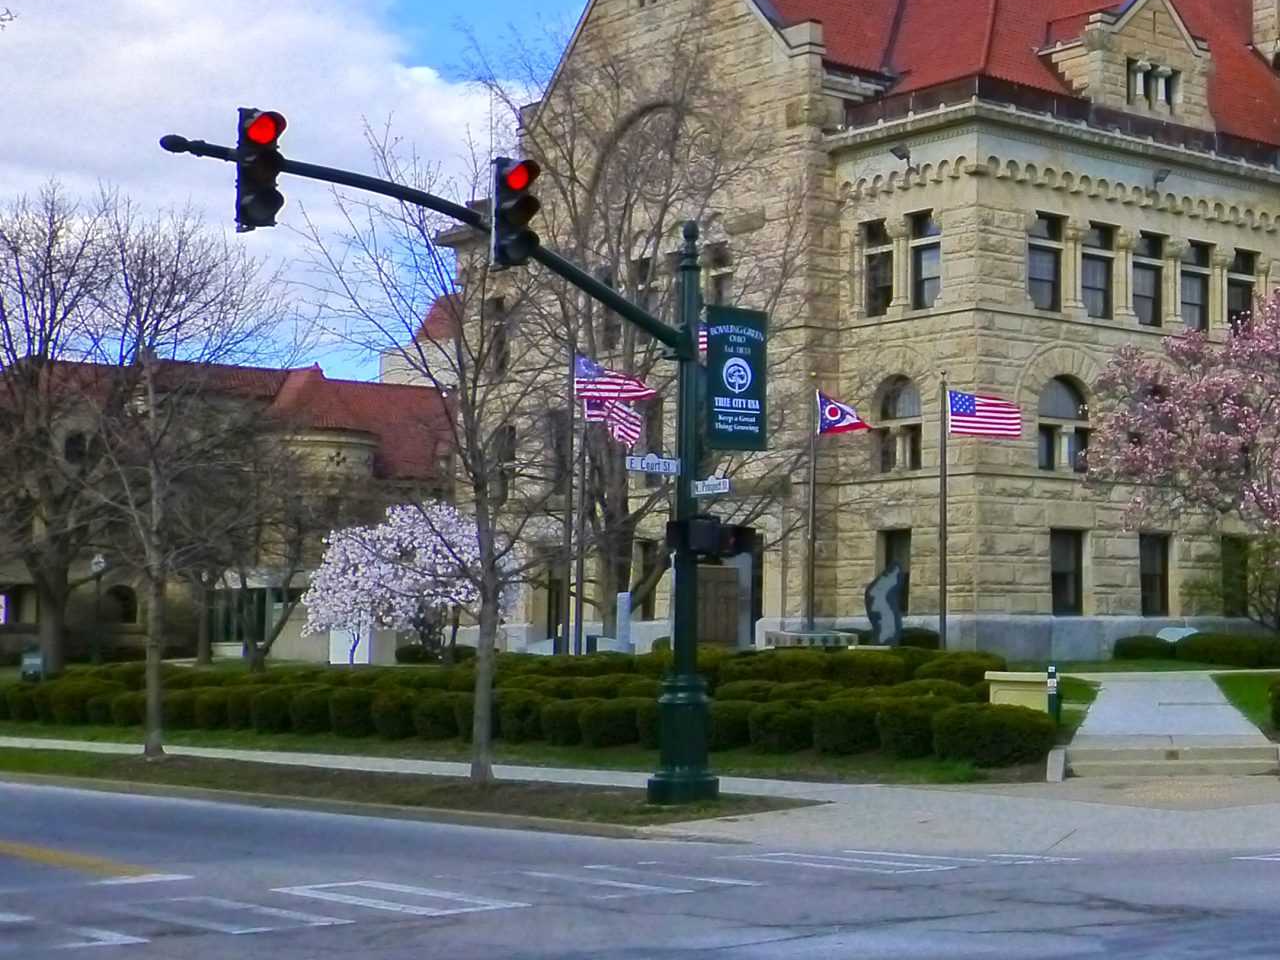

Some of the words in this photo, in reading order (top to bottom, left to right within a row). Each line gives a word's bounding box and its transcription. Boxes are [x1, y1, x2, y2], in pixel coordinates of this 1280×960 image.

[714, 396, 731, 408] TREE
[732, 398, 747, 409] CITY
[747, 399, 760, 410] USA
[640, 458, 661, 471] Court
